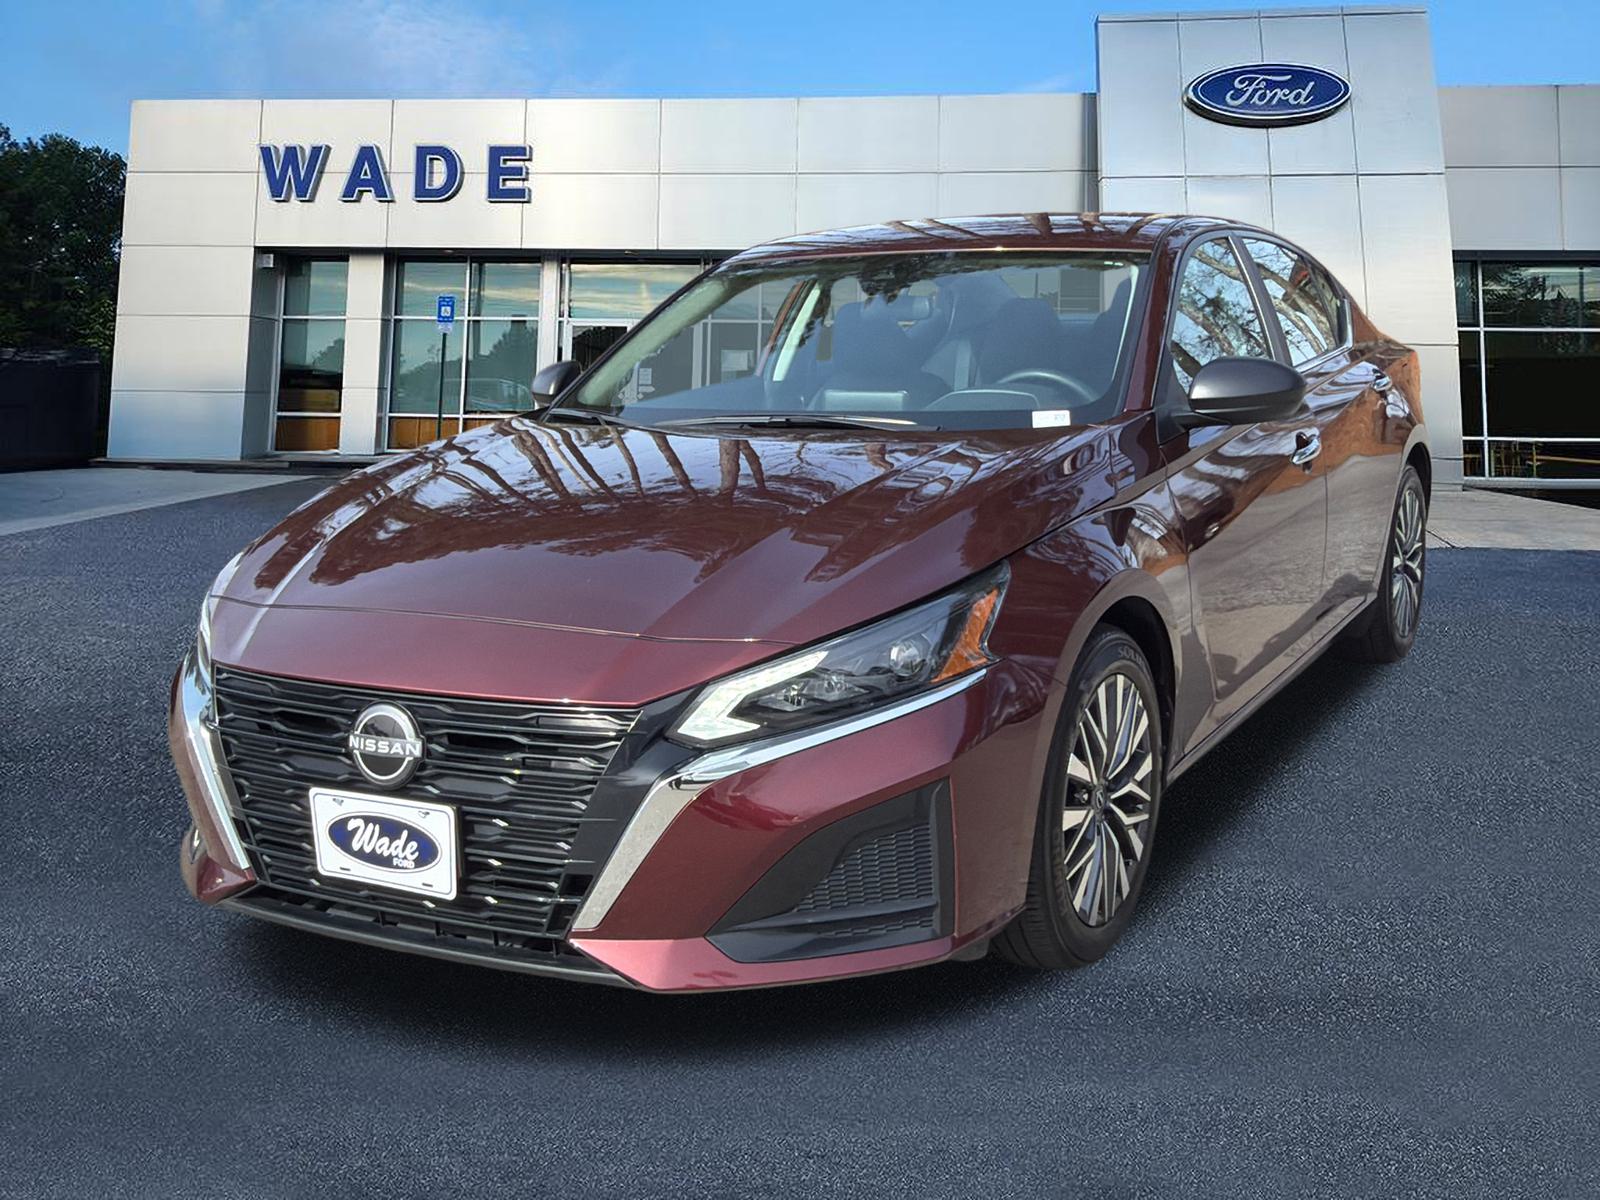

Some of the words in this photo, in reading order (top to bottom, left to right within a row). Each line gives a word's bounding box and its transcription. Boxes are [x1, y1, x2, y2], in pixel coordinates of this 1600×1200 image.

[1225, 74, 1315, 106] Ford
[258, 143, 531, 203] WADE
[349, 735, 421, 756] NISSAN
[347, 818, 419, 861] Wade
